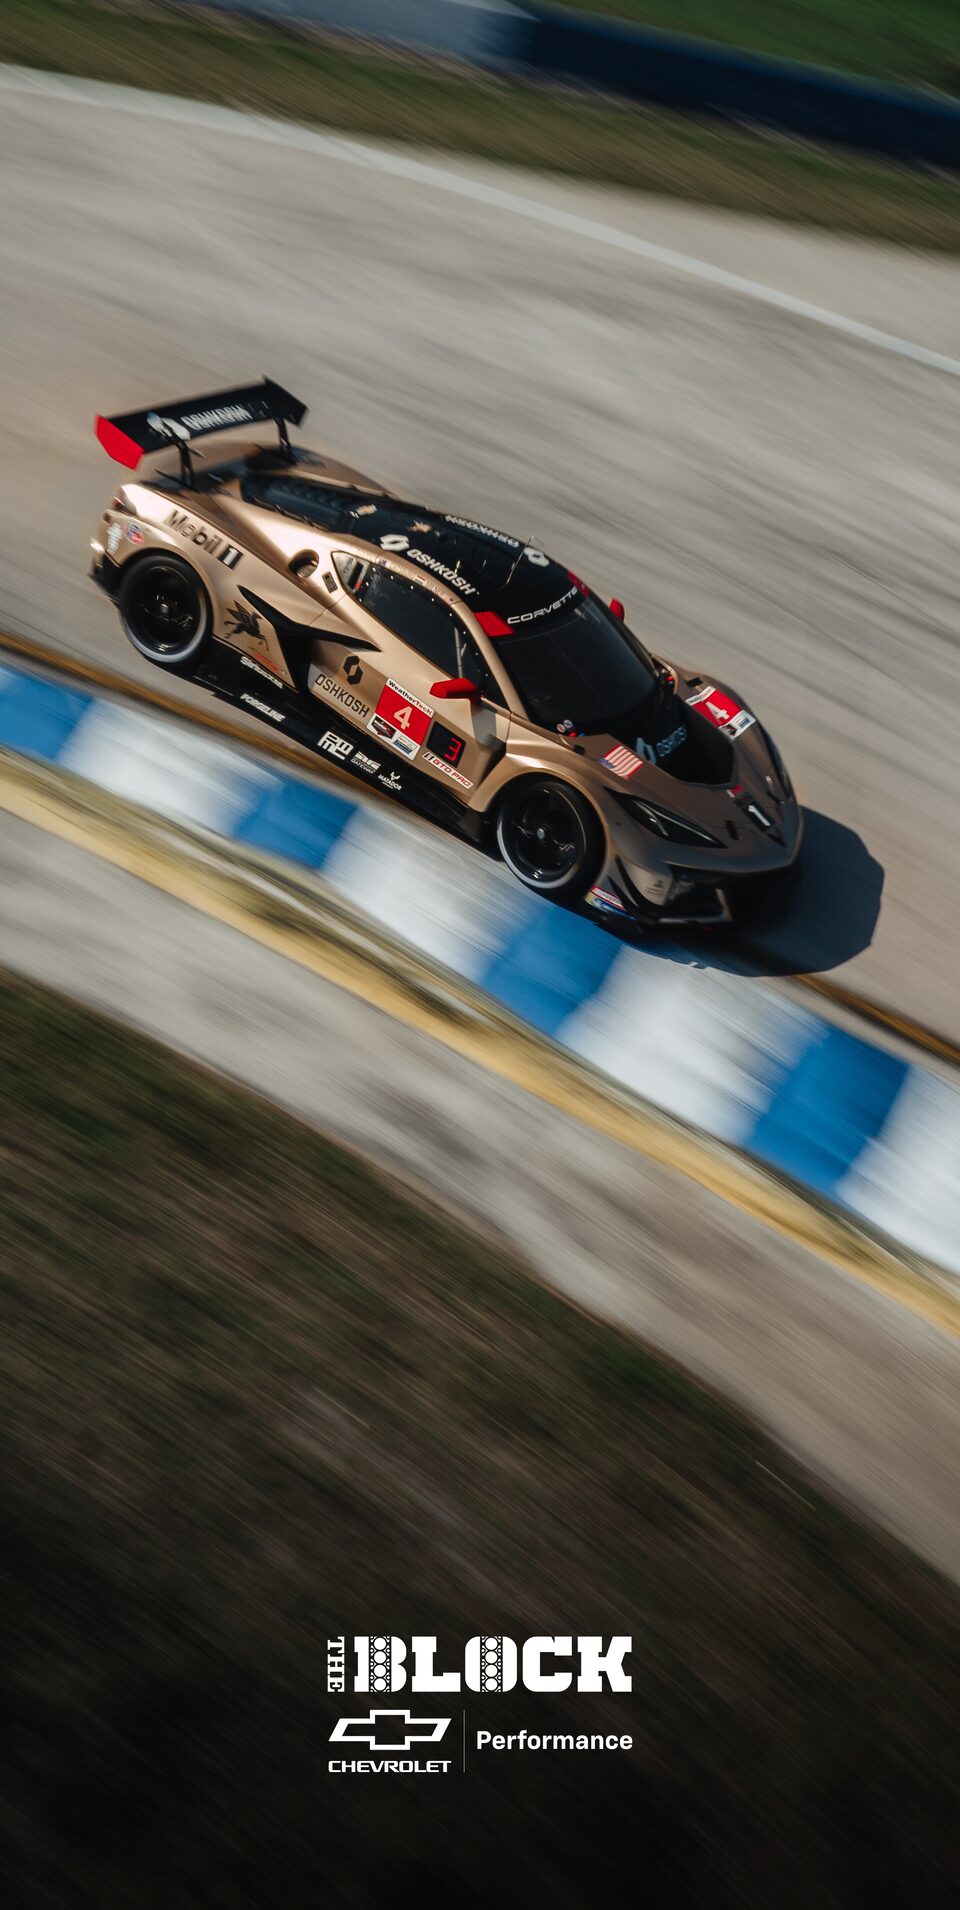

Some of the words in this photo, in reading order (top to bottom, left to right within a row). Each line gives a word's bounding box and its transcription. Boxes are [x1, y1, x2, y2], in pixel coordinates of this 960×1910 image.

[163, 509, 223, 556] Mobil
[220, 546, 241, 568] 1
[406, 548, 476, 595] OSHKOSH
[507, 585, 578, 625] CORVETTE
[314, 673, 370, 718] OSHKOSH
[388, 680, 433, 716] WeatherTech
[705, 701, 730, 721] 4
[393, 705, 413, 731] 4
[444, 737, 462, 762] 3
[432, 759, 452, 773] GTD
[451, 772, 471, 787] PRO
